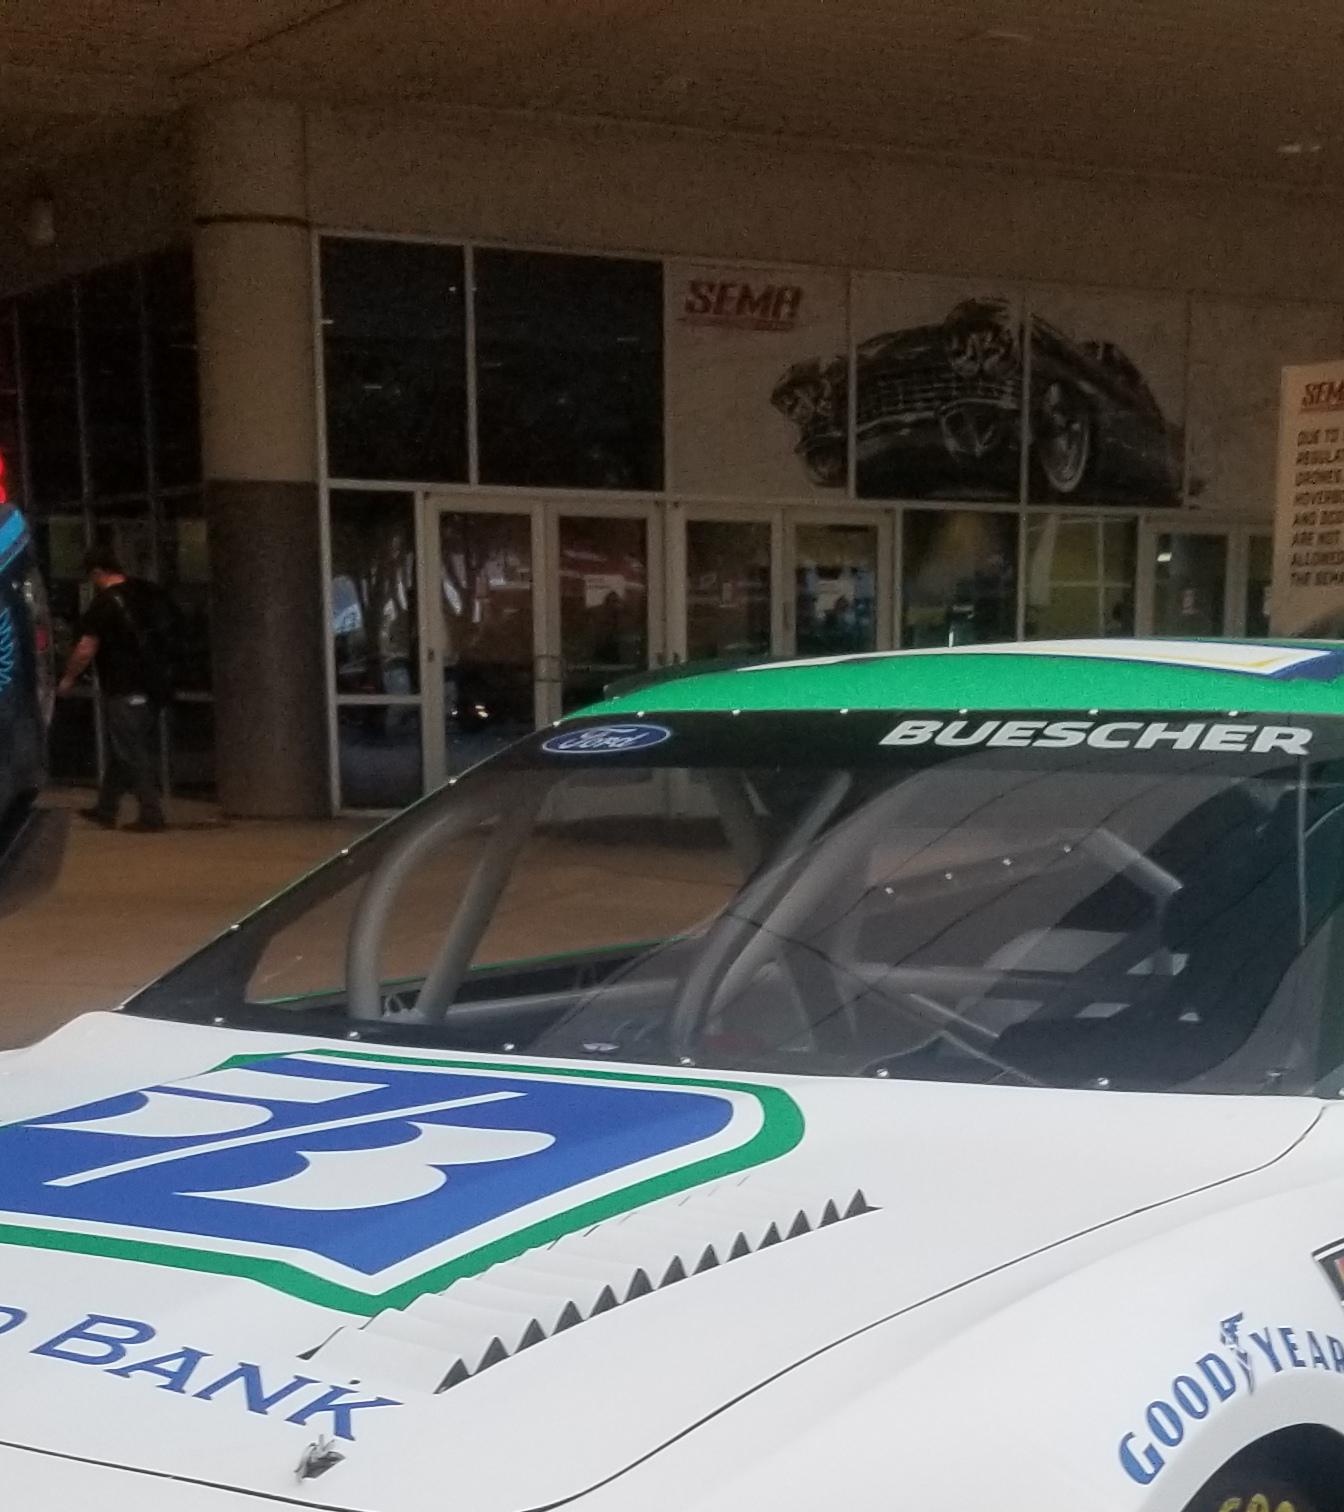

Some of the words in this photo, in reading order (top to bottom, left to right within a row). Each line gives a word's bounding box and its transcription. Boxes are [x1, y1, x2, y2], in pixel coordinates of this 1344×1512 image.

[685, 279, 803, 319] SEMA
[878, 718, 1314, 756] BUESCHER
[29, 1313, 404, 1441] BANK
